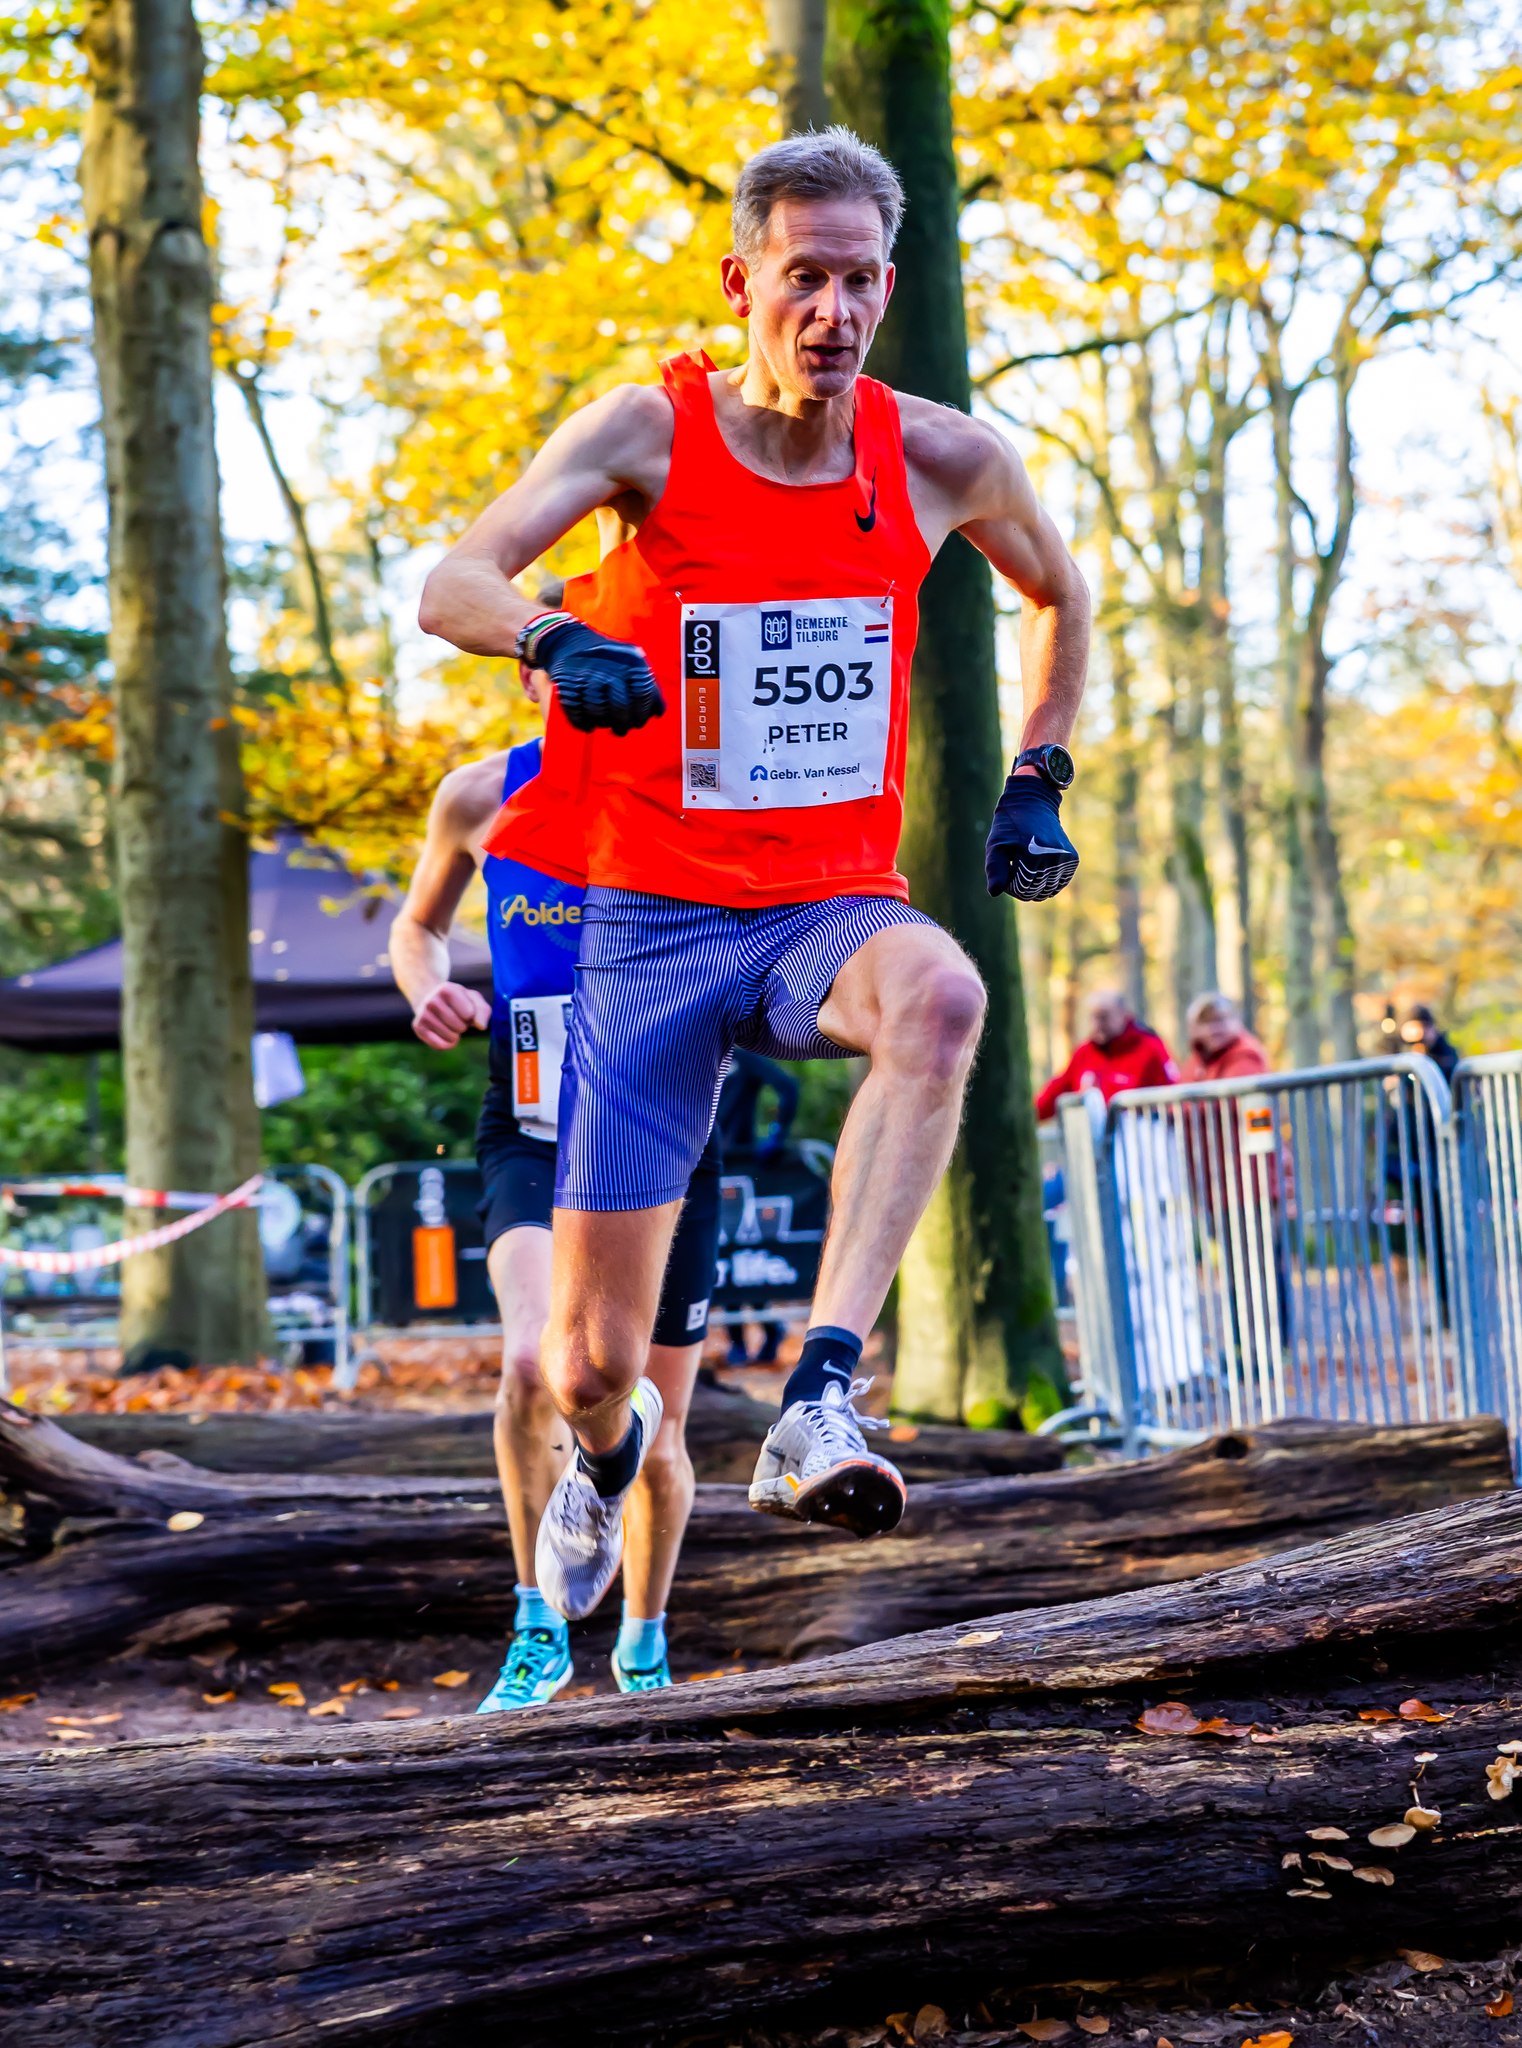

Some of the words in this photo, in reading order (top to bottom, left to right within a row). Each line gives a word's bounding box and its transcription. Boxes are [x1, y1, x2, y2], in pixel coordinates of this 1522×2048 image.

[795, 616, 848, 630] GEMEENTE
[796, 630, 839, 643] TILBURG
[687, 623, 716, 675] capi
[752, 661, 874, 706] 5503
[698, 687, 707, 741] EUROPE
[768, 722, 848, 744] PETER
[769, 769, 801, 780] Gebr.
[803, 767, 825, 779] Van
[827, 763, 861, 777] Kessel
